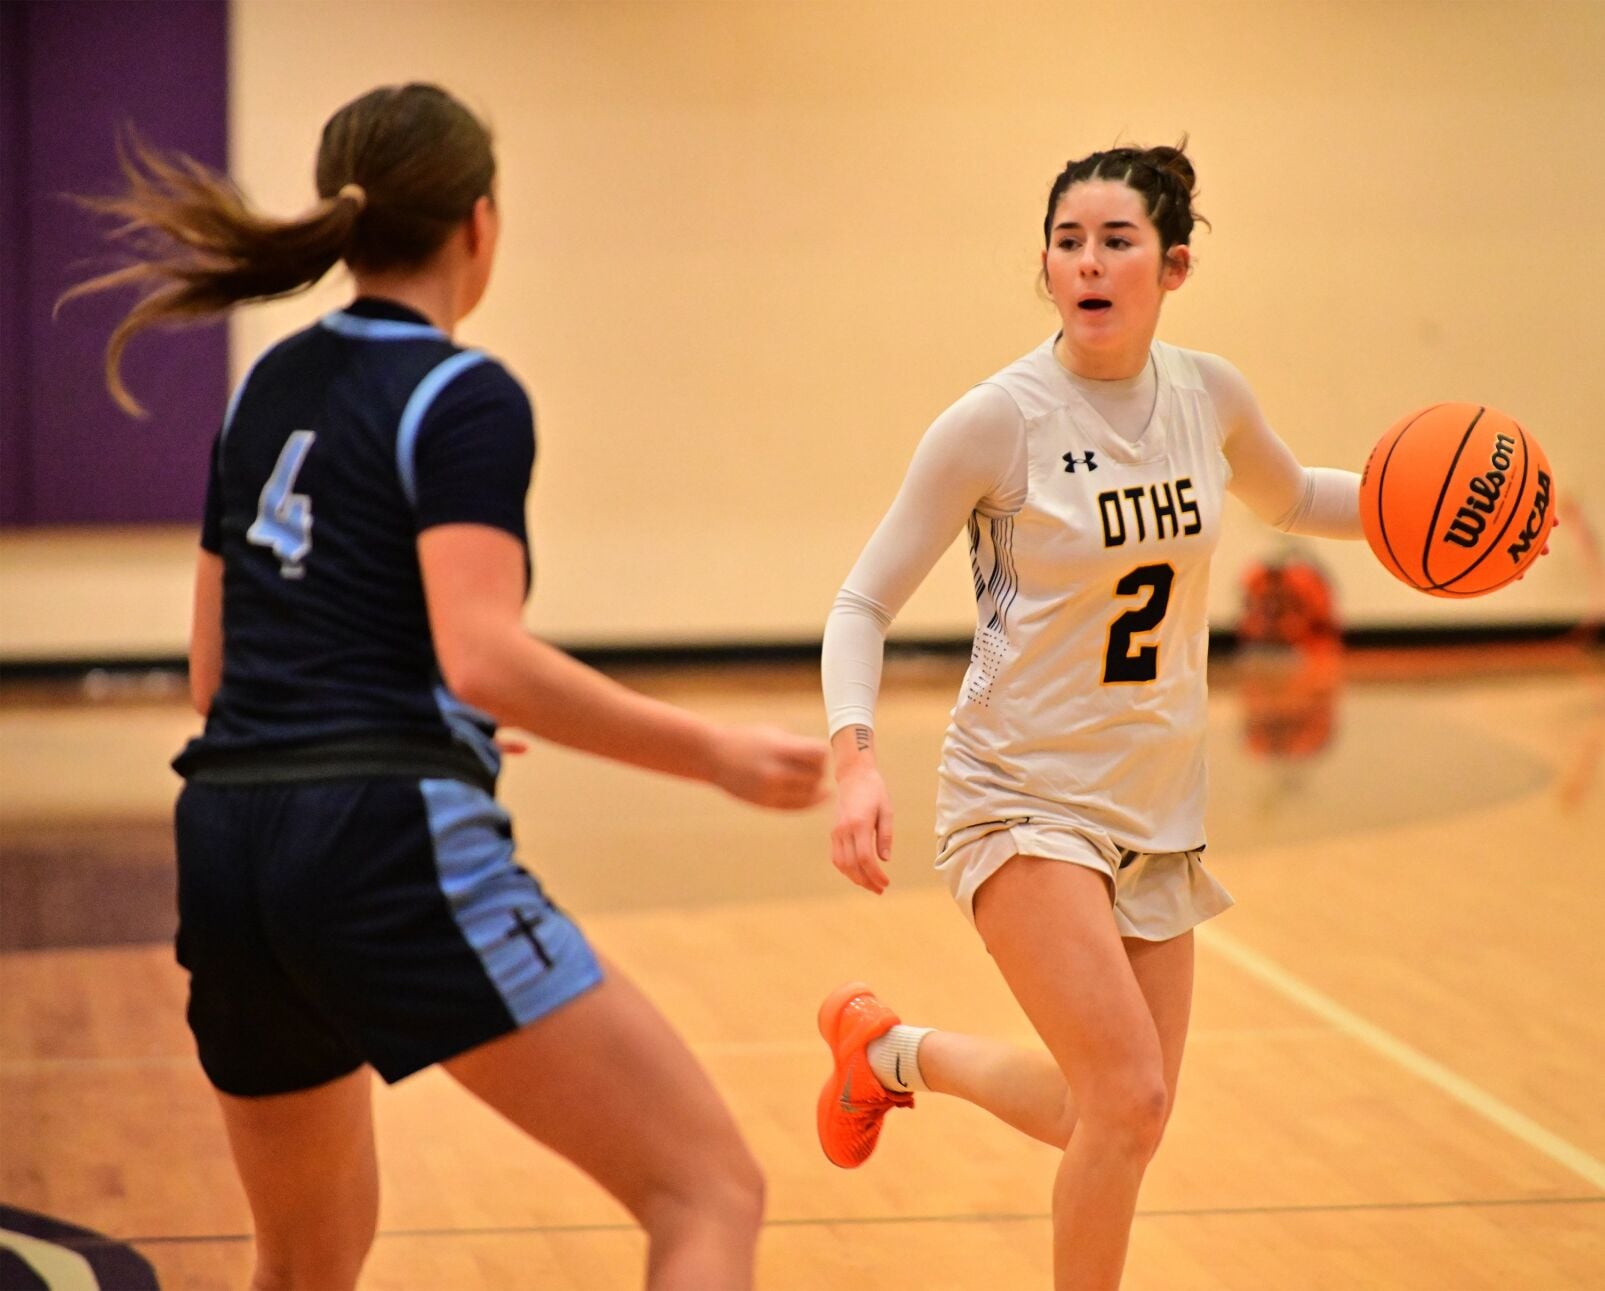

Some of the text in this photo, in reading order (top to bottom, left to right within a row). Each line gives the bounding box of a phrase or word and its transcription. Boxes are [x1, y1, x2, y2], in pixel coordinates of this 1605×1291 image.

[246, 429, 317, 579] 4
[1097, 477, 1202, 548] OTHS
[1443, 432, 1516, 549] Wilson
[1507, 469, 1551, 565] NCAA
[1102, 561, 1176, 685] 2
